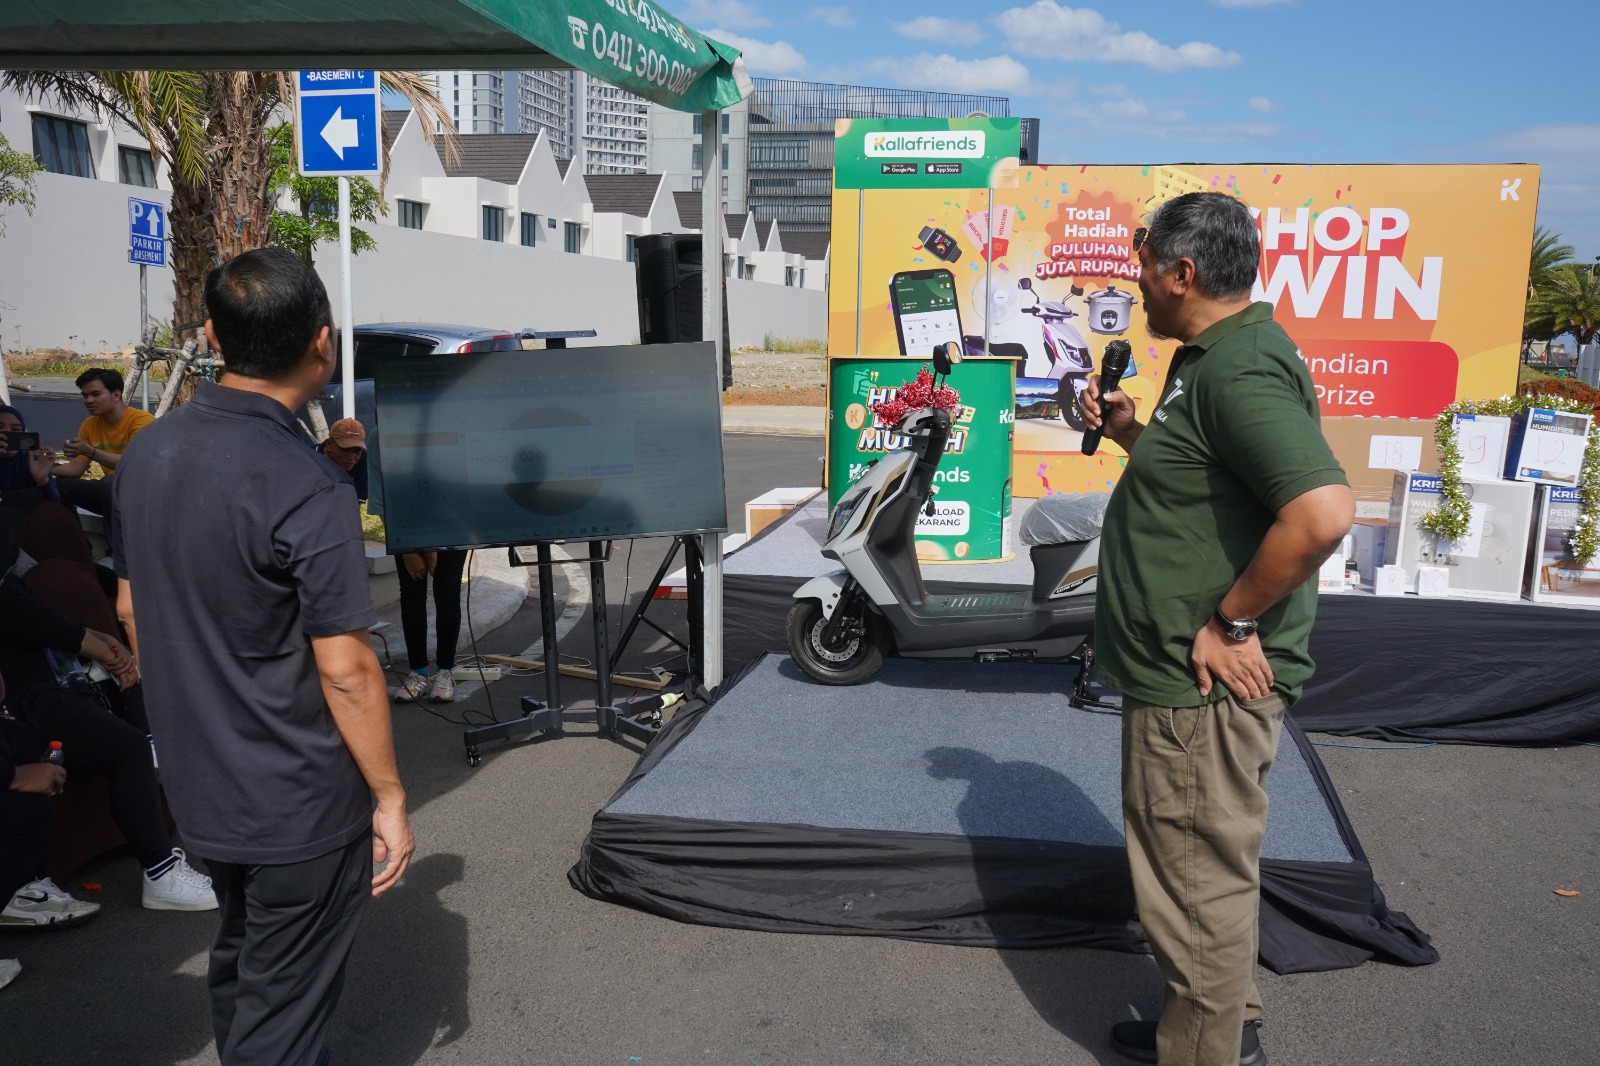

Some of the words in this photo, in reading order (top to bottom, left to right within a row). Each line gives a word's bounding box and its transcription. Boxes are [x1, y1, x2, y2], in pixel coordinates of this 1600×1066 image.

[592, 22, 633, 73] 0411
[635, 43, 669, 87] 300
[873, 136, 977, 151] Kallafriends
[130, 200, 144, 225] P
[1065, 206, 1111, 221] Total
[1064, 222, 1129, 238] Hadiah
[1248, 206, 1410, 251] HOP
[132, 236, 162, 252] PARKIR
[1051, 242, 1130, 258] PULUHAN
[133, 249, 162, 263] BASEMENT
[1036, 260, 1078, 277] JUTA
[1080, 260, 1142, 279] RUPIAH
[1250, 254, 1443, 320] WIN
[1304, 353, 1389, 375] ndian
[1533, 413, 1554, 421] KRIS
[1531, 423, 1575, 434] HUMIDIFIER
[1536, 437, 1566, 466] 12
[1411, 500, 1438, 508] WALL
[1548, 516, 1567, 524] FAN
